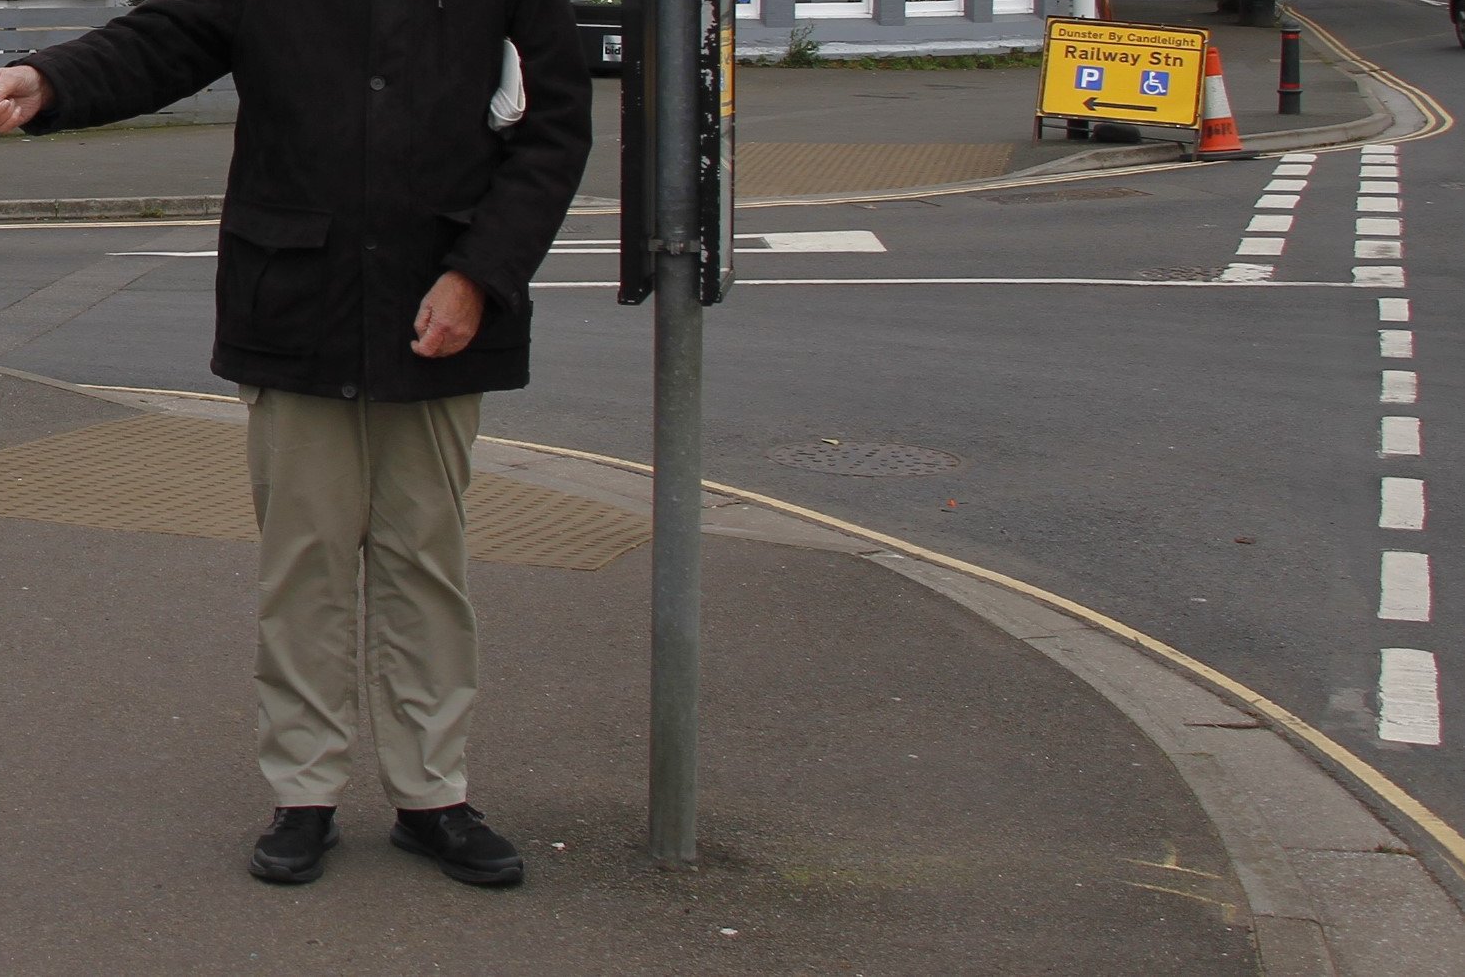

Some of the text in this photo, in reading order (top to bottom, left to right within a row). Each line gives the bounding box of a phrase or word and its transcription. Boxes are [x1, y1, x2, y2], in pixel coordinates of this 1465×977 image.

[1058, 27, 1196, 48] Dunster By Candlelight
[1064, 44, 1184, 67] Railway Stn
[1080, 67, 1100, 88] P
